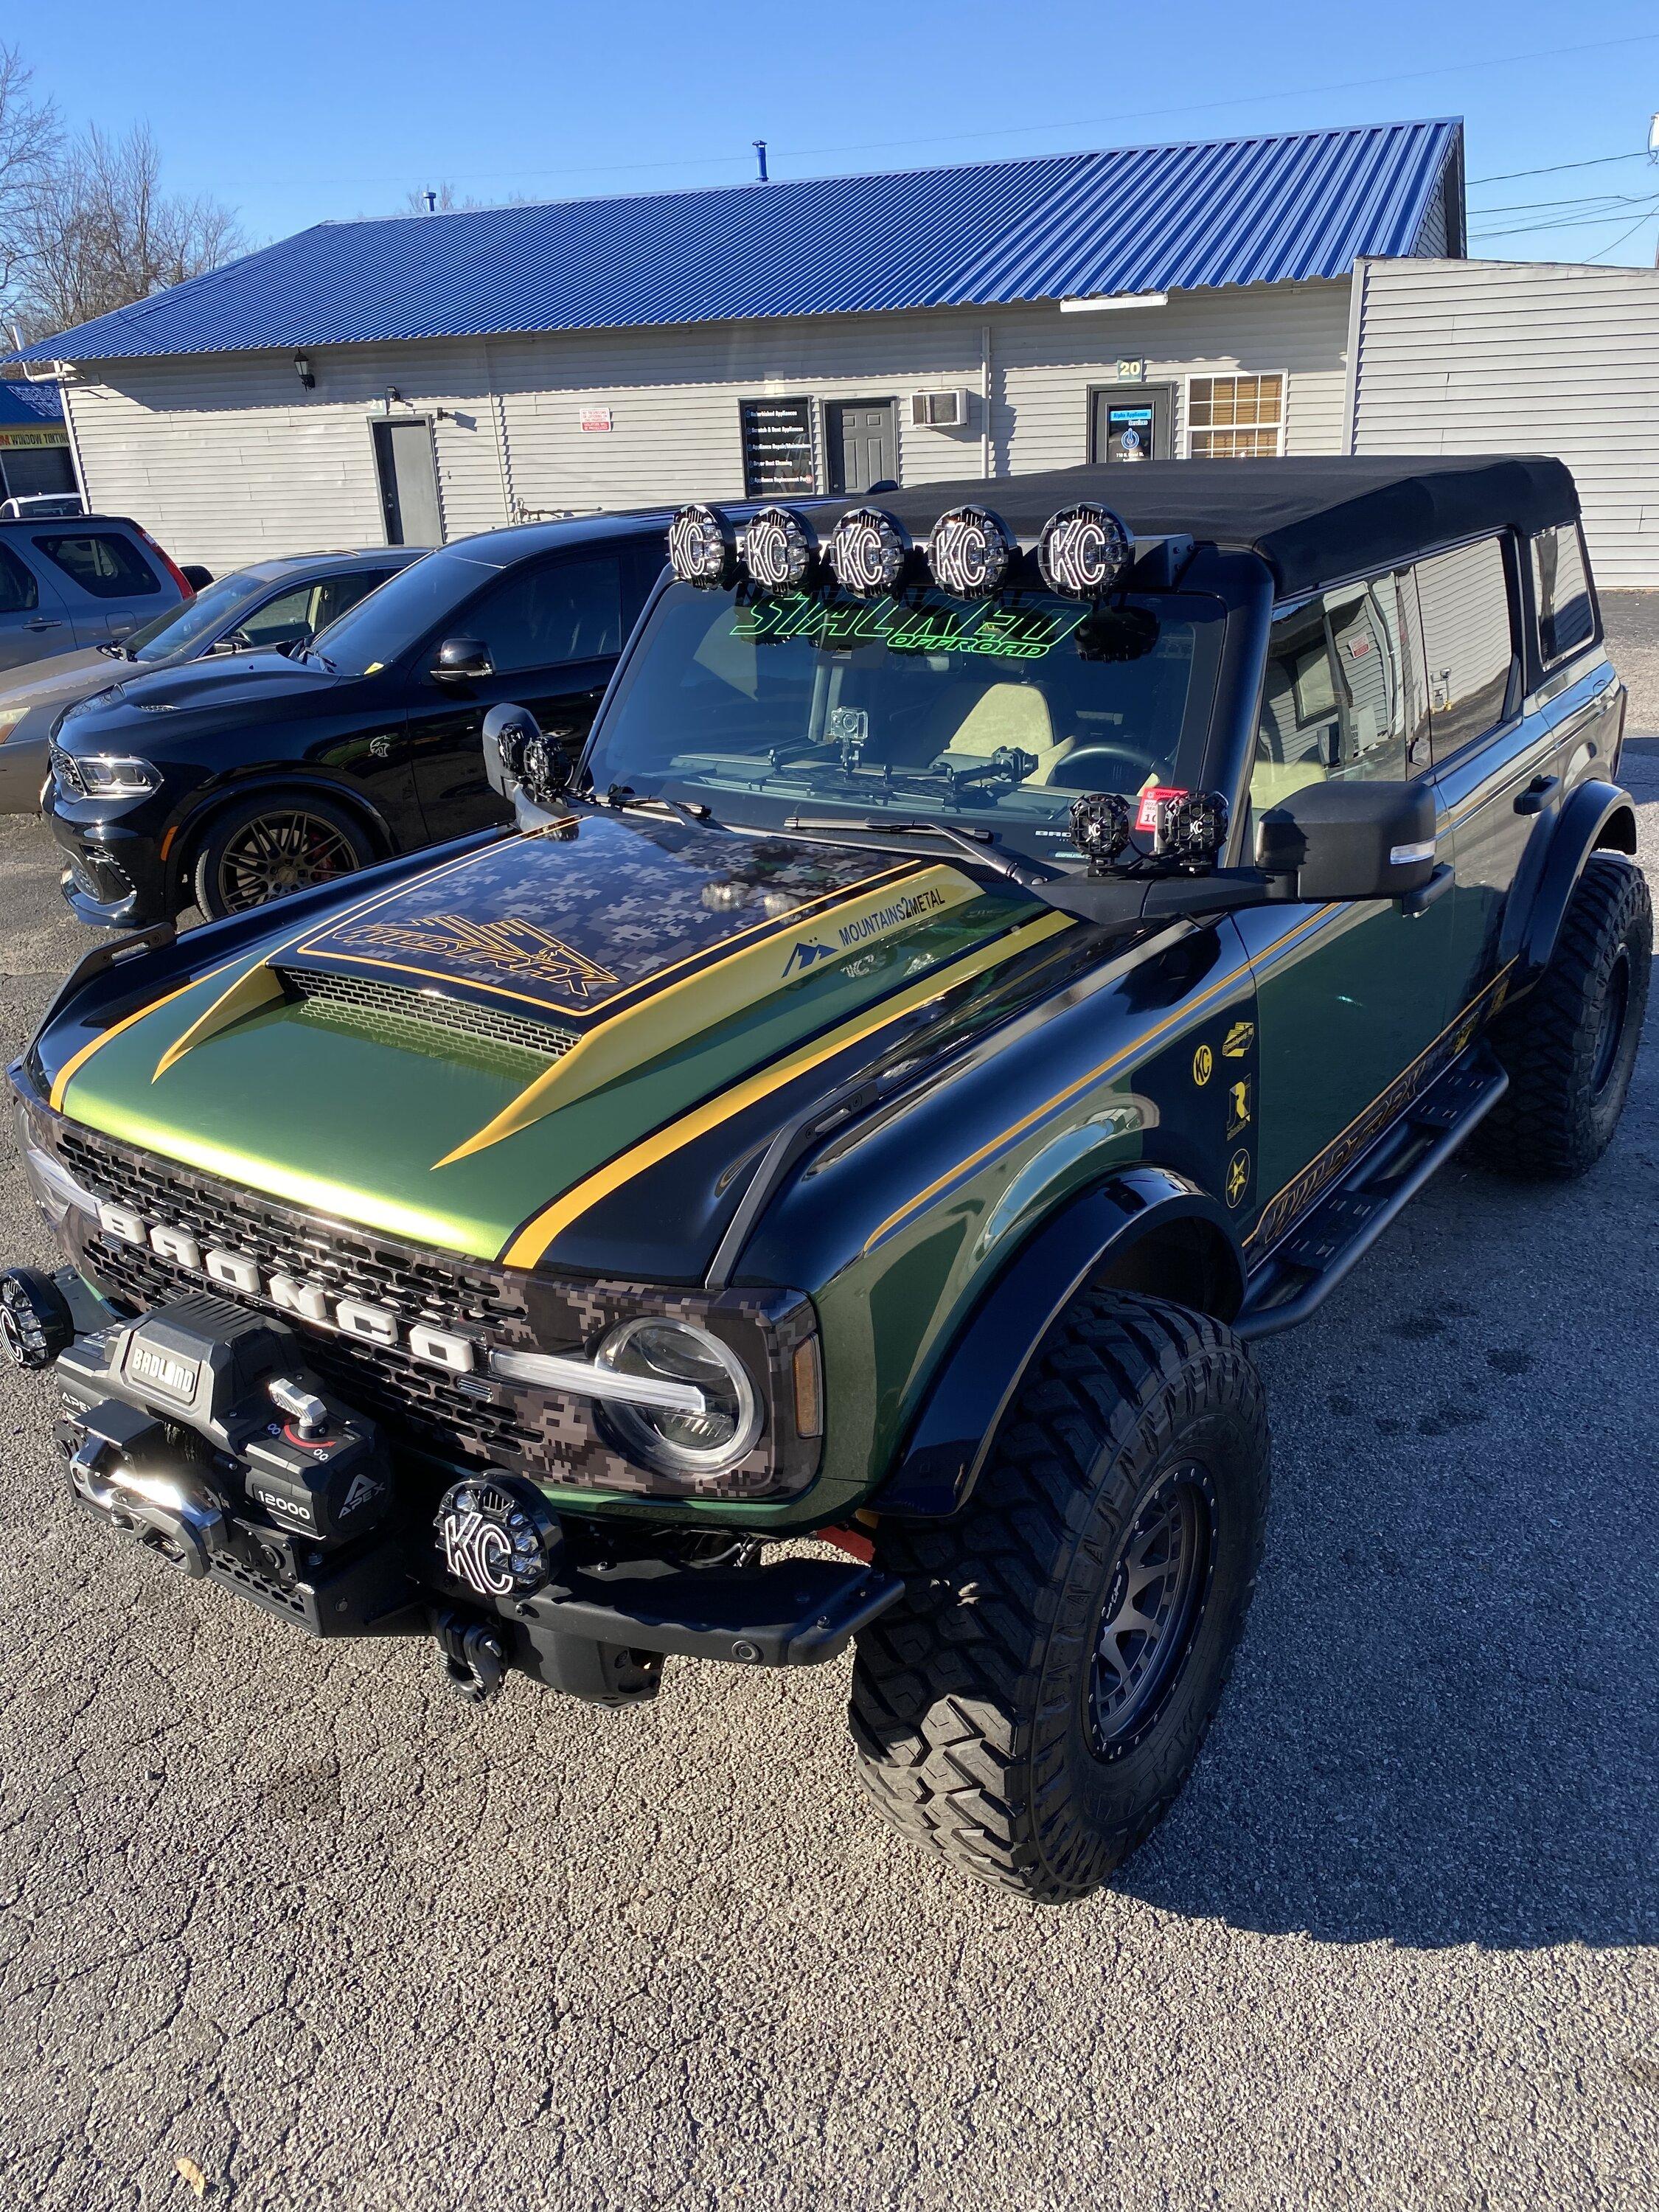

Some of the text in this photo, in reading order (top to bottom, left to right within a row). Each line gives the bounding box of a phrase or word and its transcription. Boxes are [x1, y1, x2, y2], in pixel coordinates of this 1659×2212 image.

[1119, 361, 1141, 376] 20
[11, 434, 42, 445] WINDOW
[782, 425, 804, 434] Appliances
[669, 518, 705, 579] KC
[747, 522, 788, 585] KC
[836, 524, 883, 589] KC
[936, 522, 986, 590] KC
[1050, 519, 1105, 590] KC
[888, 633, 1050, 658] OFFROAD
[1189, 820, 1203, 835] KC
[838, 888, 945, 947] MOUNTAINS2METAL
[1195, 1046, 1211, 1083] KC
[100, 1203, 475, 1374] BRONCO
[257, 1489, 311, 1520] 12000
[338, 1481, 386, 1520] APEX
[444, 1511, 514, 1595] KC
